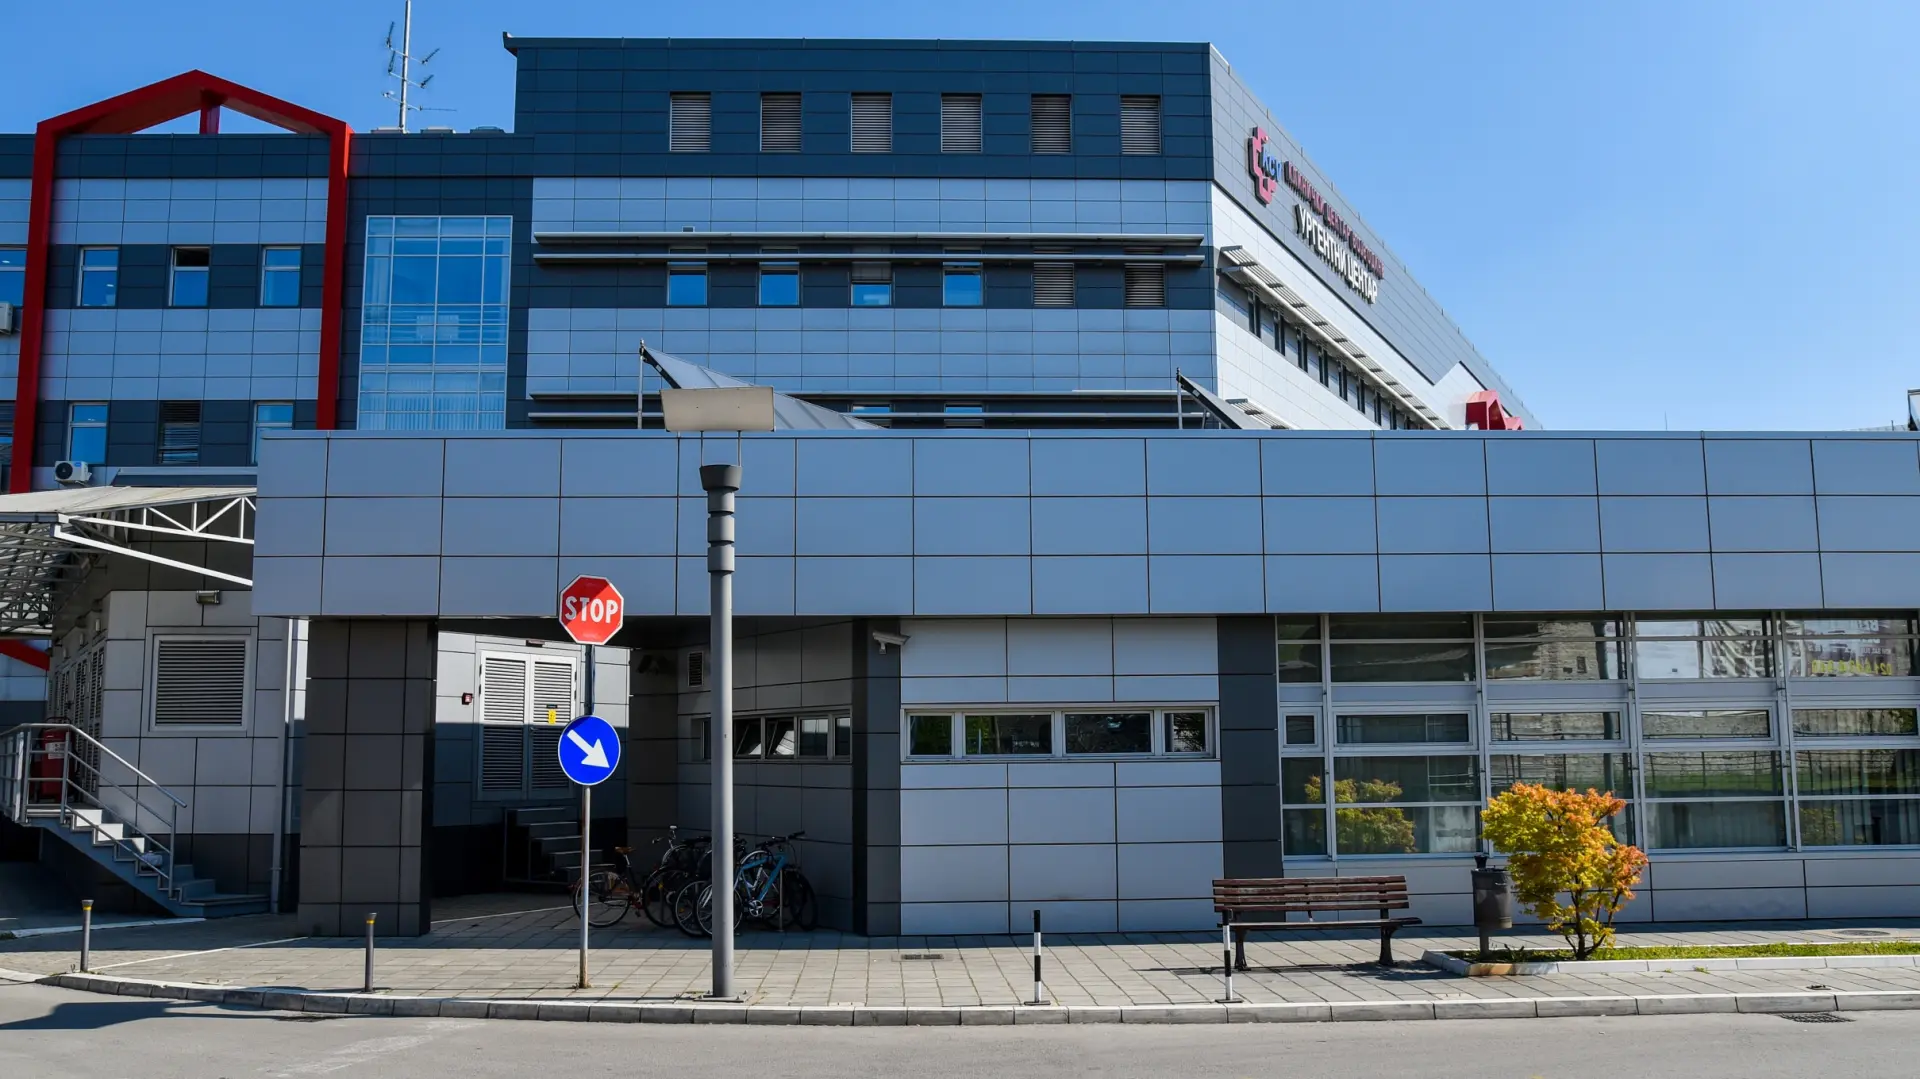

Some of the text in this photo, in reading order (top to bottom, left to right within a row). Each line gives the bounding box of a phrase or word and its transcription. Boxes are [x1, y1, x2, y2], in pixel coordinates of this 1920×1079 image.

[1297, 204, 1378, 303] УРГЕНТНИ ЦЕНТАР
[565, 596, 618, 623] STOP
